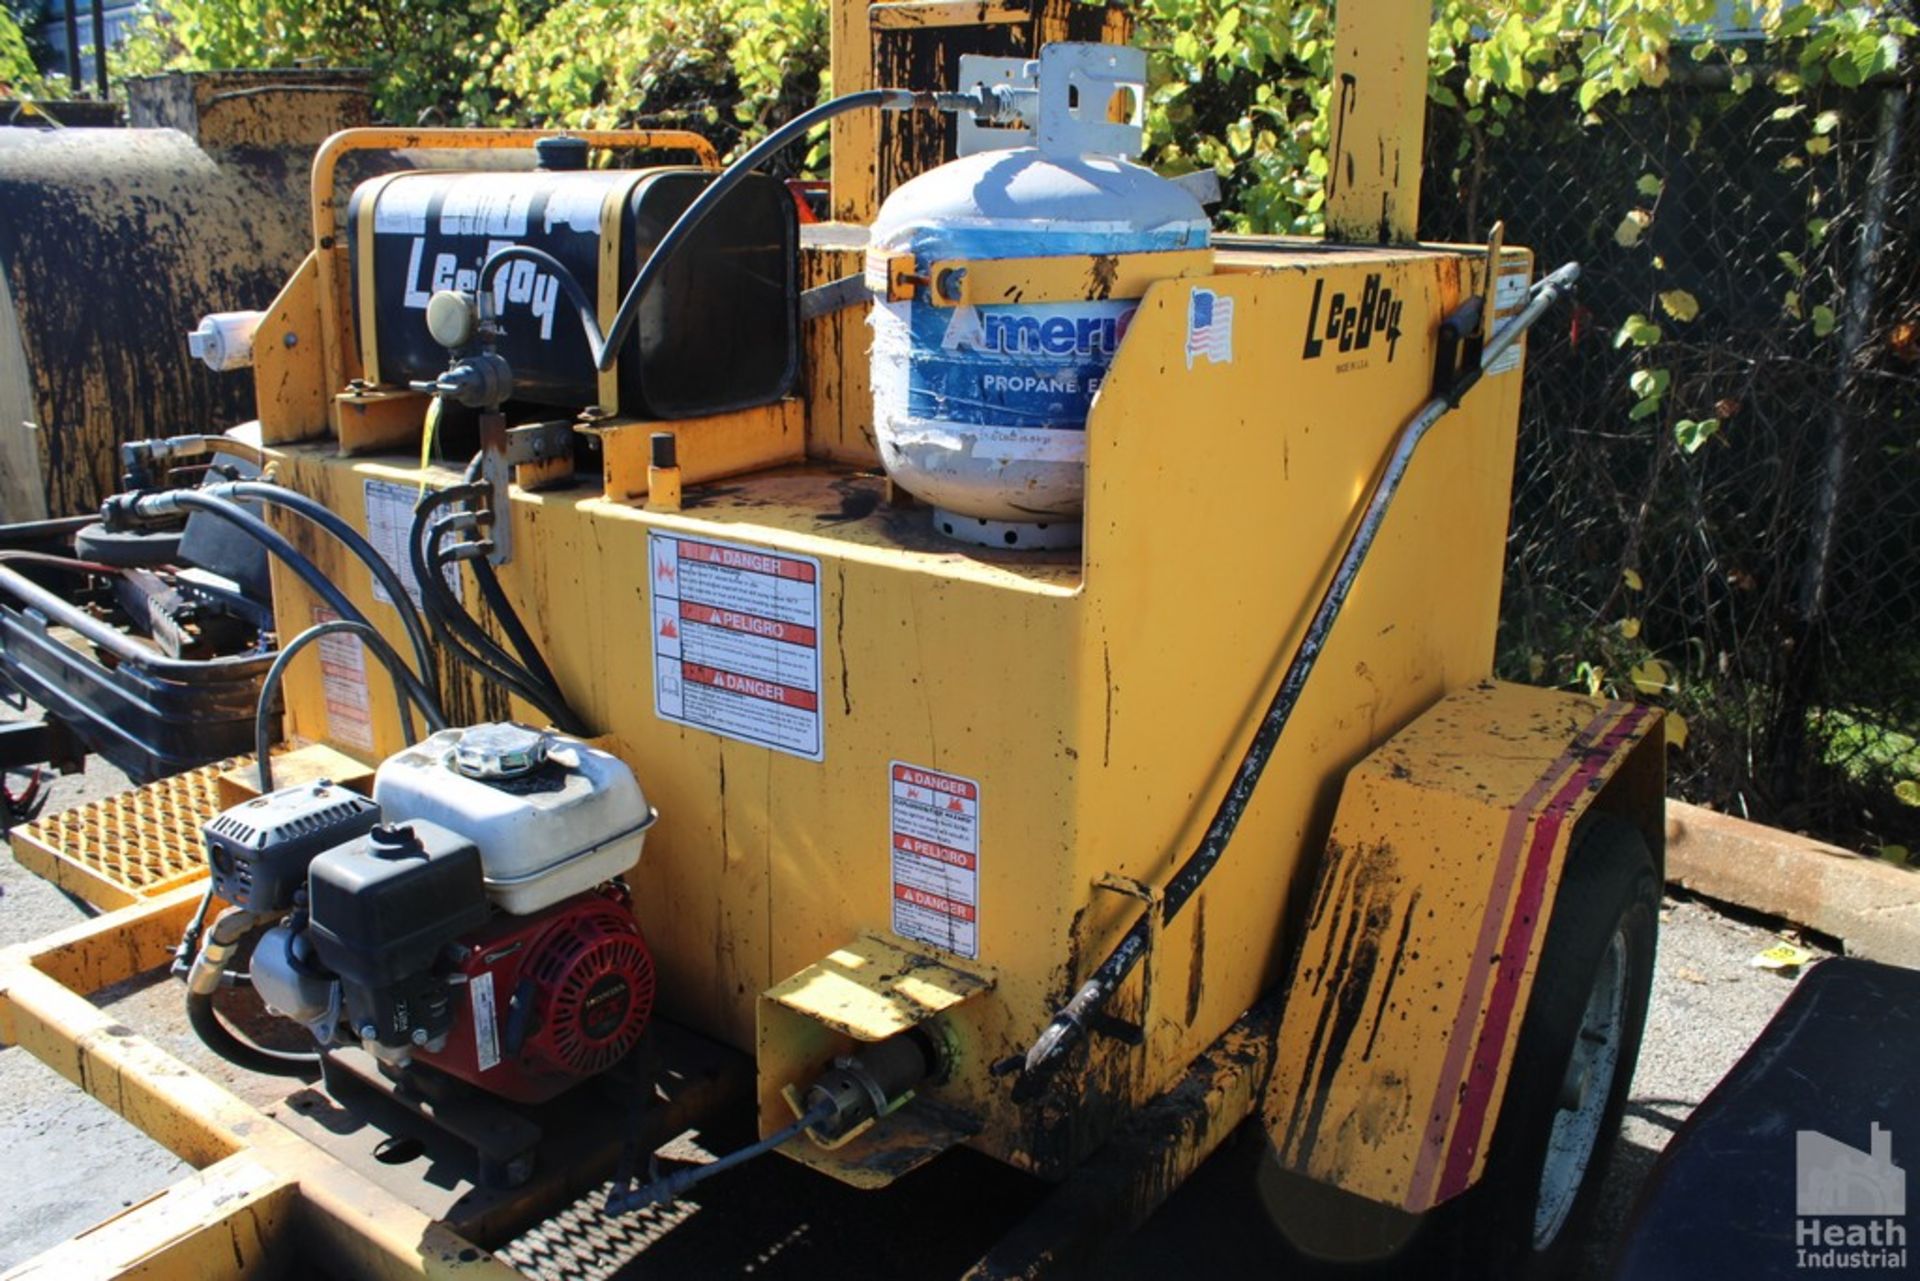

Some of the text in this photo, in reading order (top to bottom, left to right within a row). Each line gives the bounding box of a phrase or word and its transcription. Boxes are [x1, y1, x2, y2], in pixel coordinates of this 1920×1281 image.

[1303, 274, 1402, 362] LeeBoy
[941, 305, 1135, 356] Ameri
[984, 374, 1104, 393] PROPANE E
[723, 552, 781, 575] DANGER
[723, 615, 785, 638] PELIGRO
[727, 678, 785, 701] DANGER
[914, 773, 967, 796] DANGER
[914, 842, 967, 866] PELIGRO
[916, 893, 967, 917] DANGER
